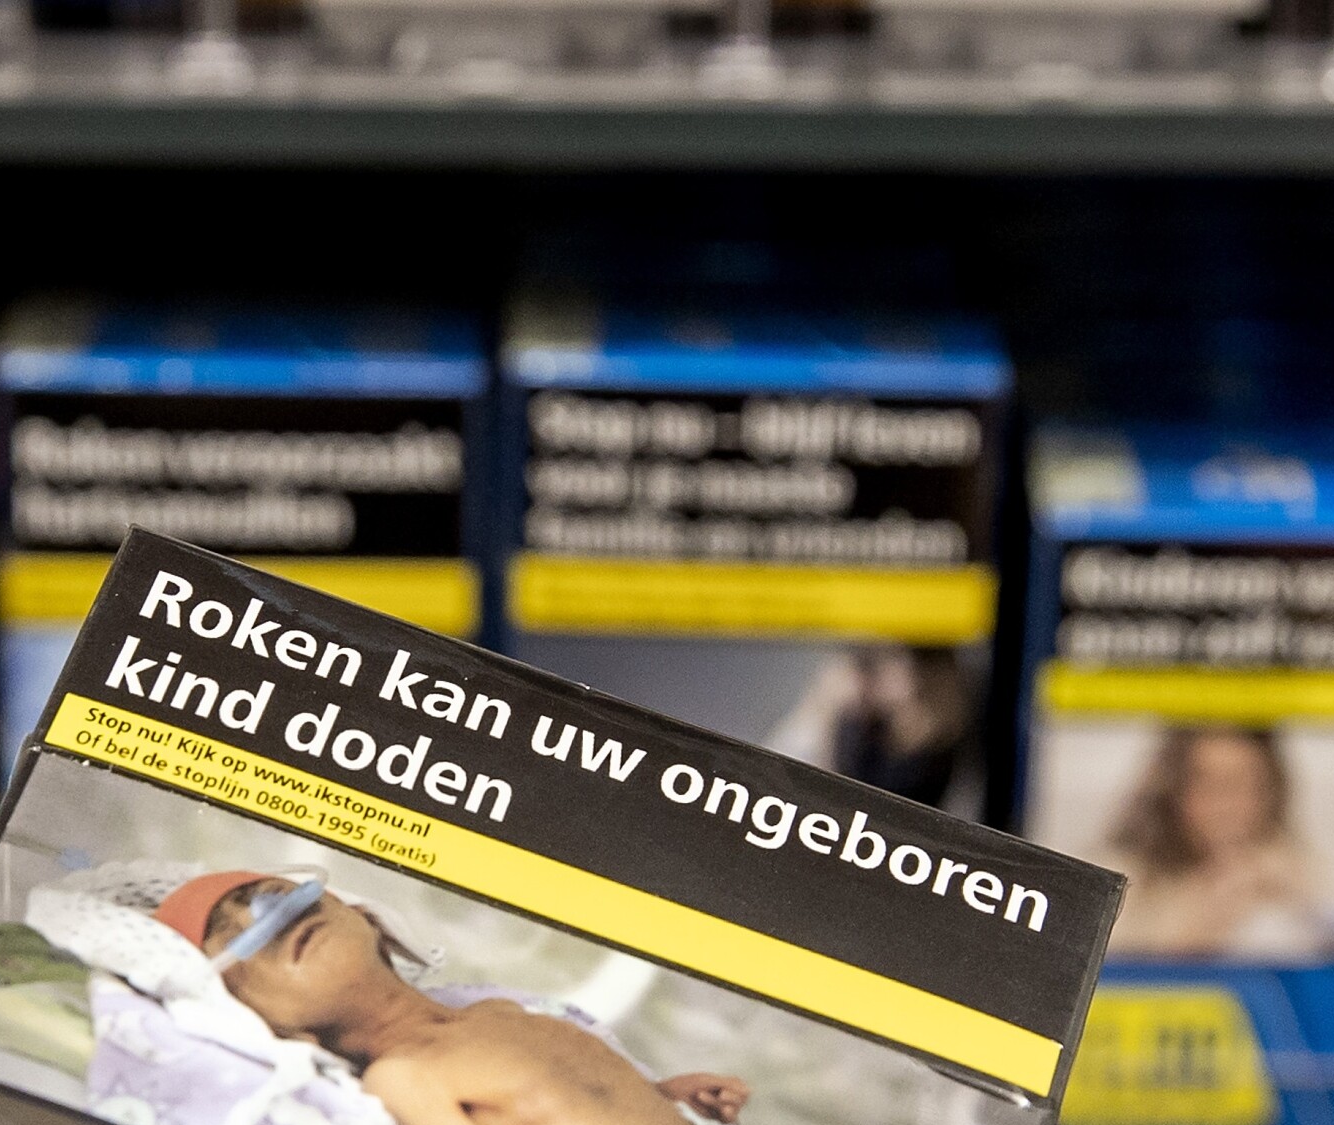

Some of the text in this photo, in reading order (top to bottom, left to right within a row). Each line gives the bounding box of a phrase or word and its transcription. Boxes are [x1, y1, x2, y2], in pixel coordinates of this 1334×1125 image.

[75, 729, 436, 868] Of bel de stoplijn 0800-1995 (gratis)
[84, 706, 431, 838] Stop nu! Kijk op www.ikstopnu.nl
[104, 635, 513, 822] kind doden
[139, 570, 1049, 932] Roken kan uw ongeboren
